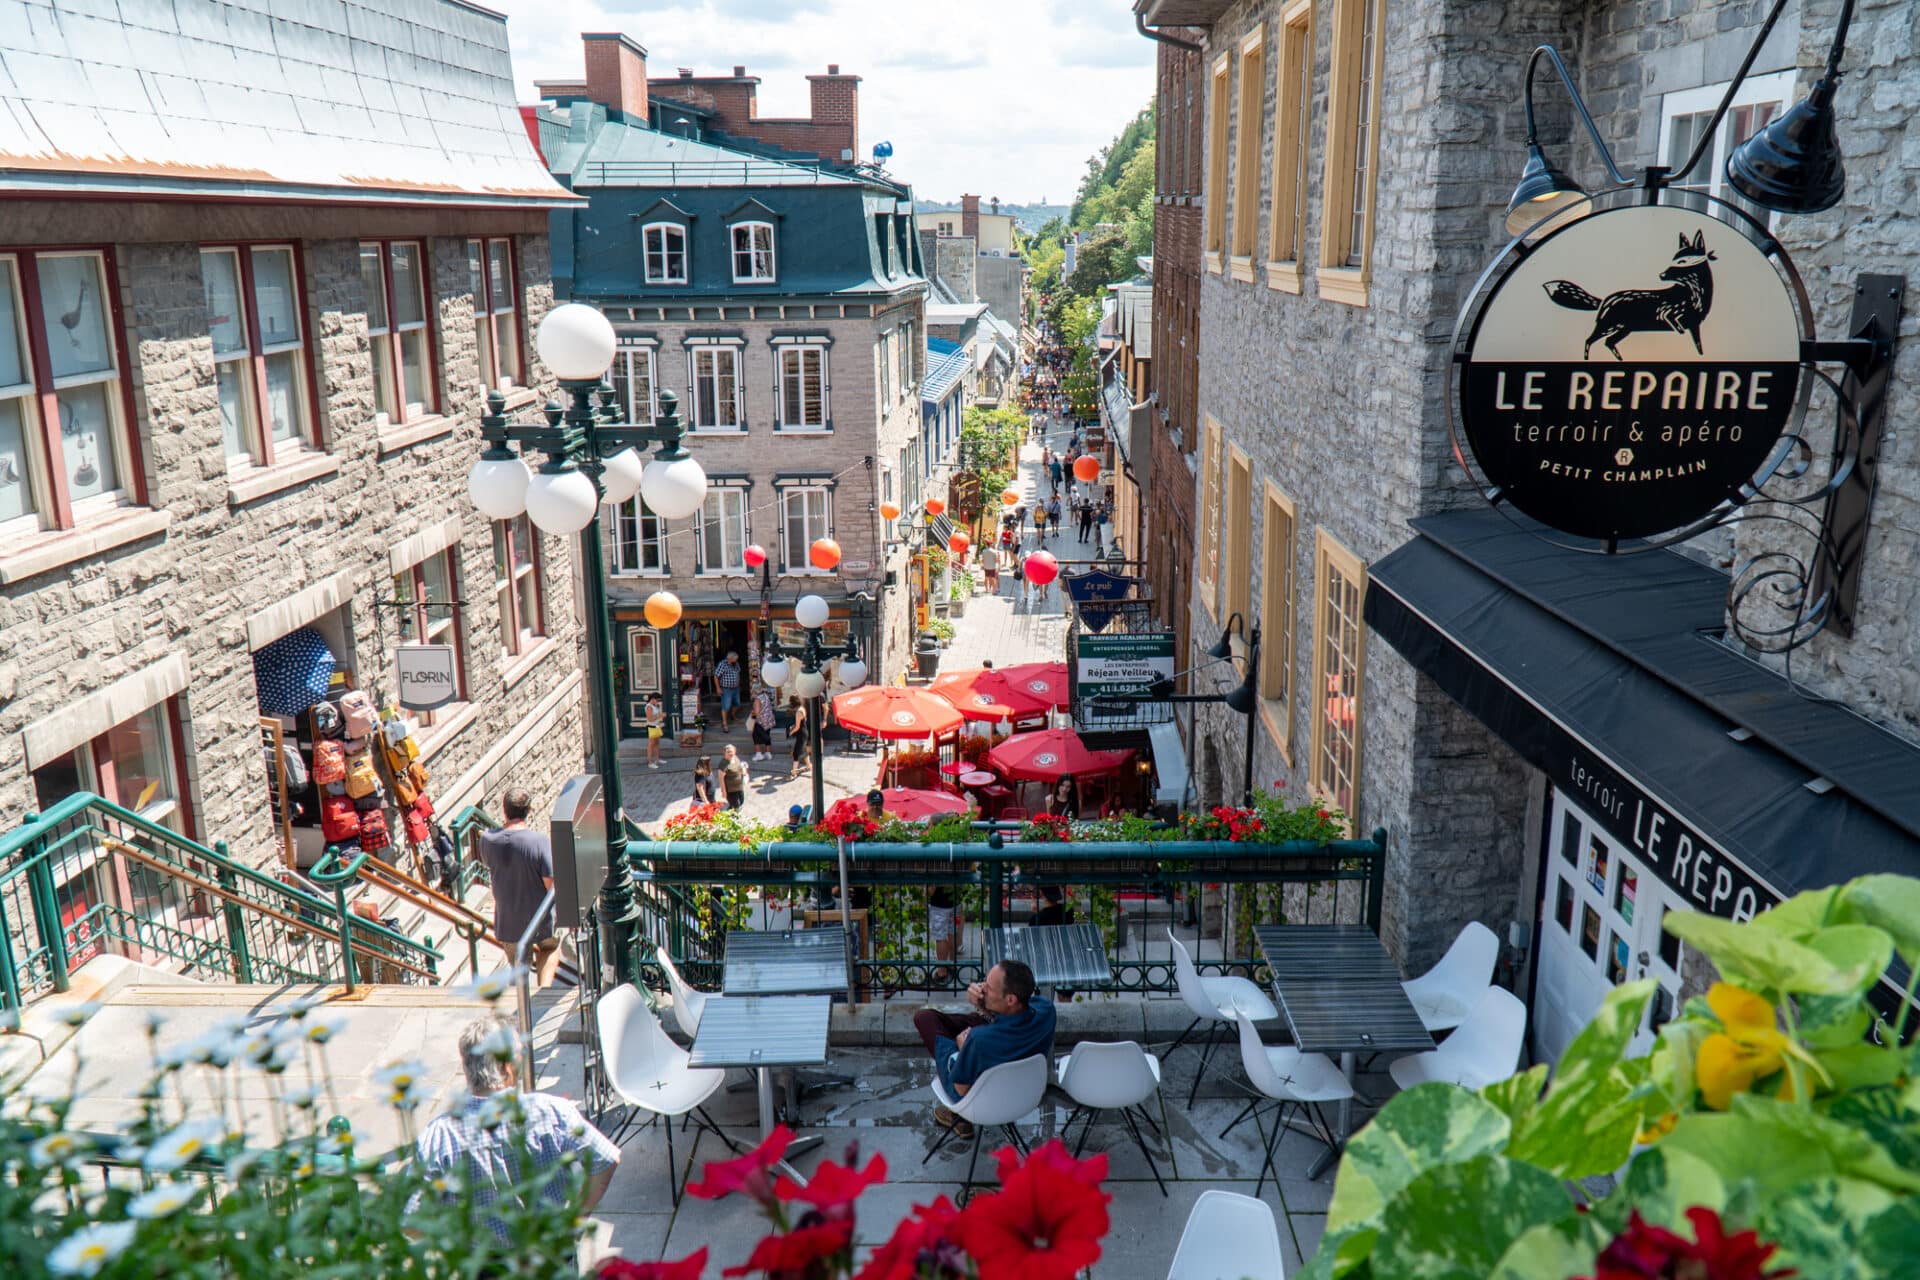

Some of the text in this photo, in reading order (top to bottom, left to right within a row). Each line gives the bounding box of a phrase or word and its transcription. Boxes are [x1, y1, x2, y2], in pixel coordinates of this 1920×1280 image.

[1495, 370, 1773, 411] LE REPAIRE
[1513, 420, 1743, 447] terroir & apéro
[1540, 458, 1707, 482] PETIT CHAMPLAIN
[1096, 581, 1112, 591] pub
[402, 671, 451, 683] FLORIN
[1088, 668, 1119, 678] Réjean
[1570, 757, 1624, 820] terroir
[1632, 799, 1666, 863] LE
[1671, 832, 1771, 923] REPA
